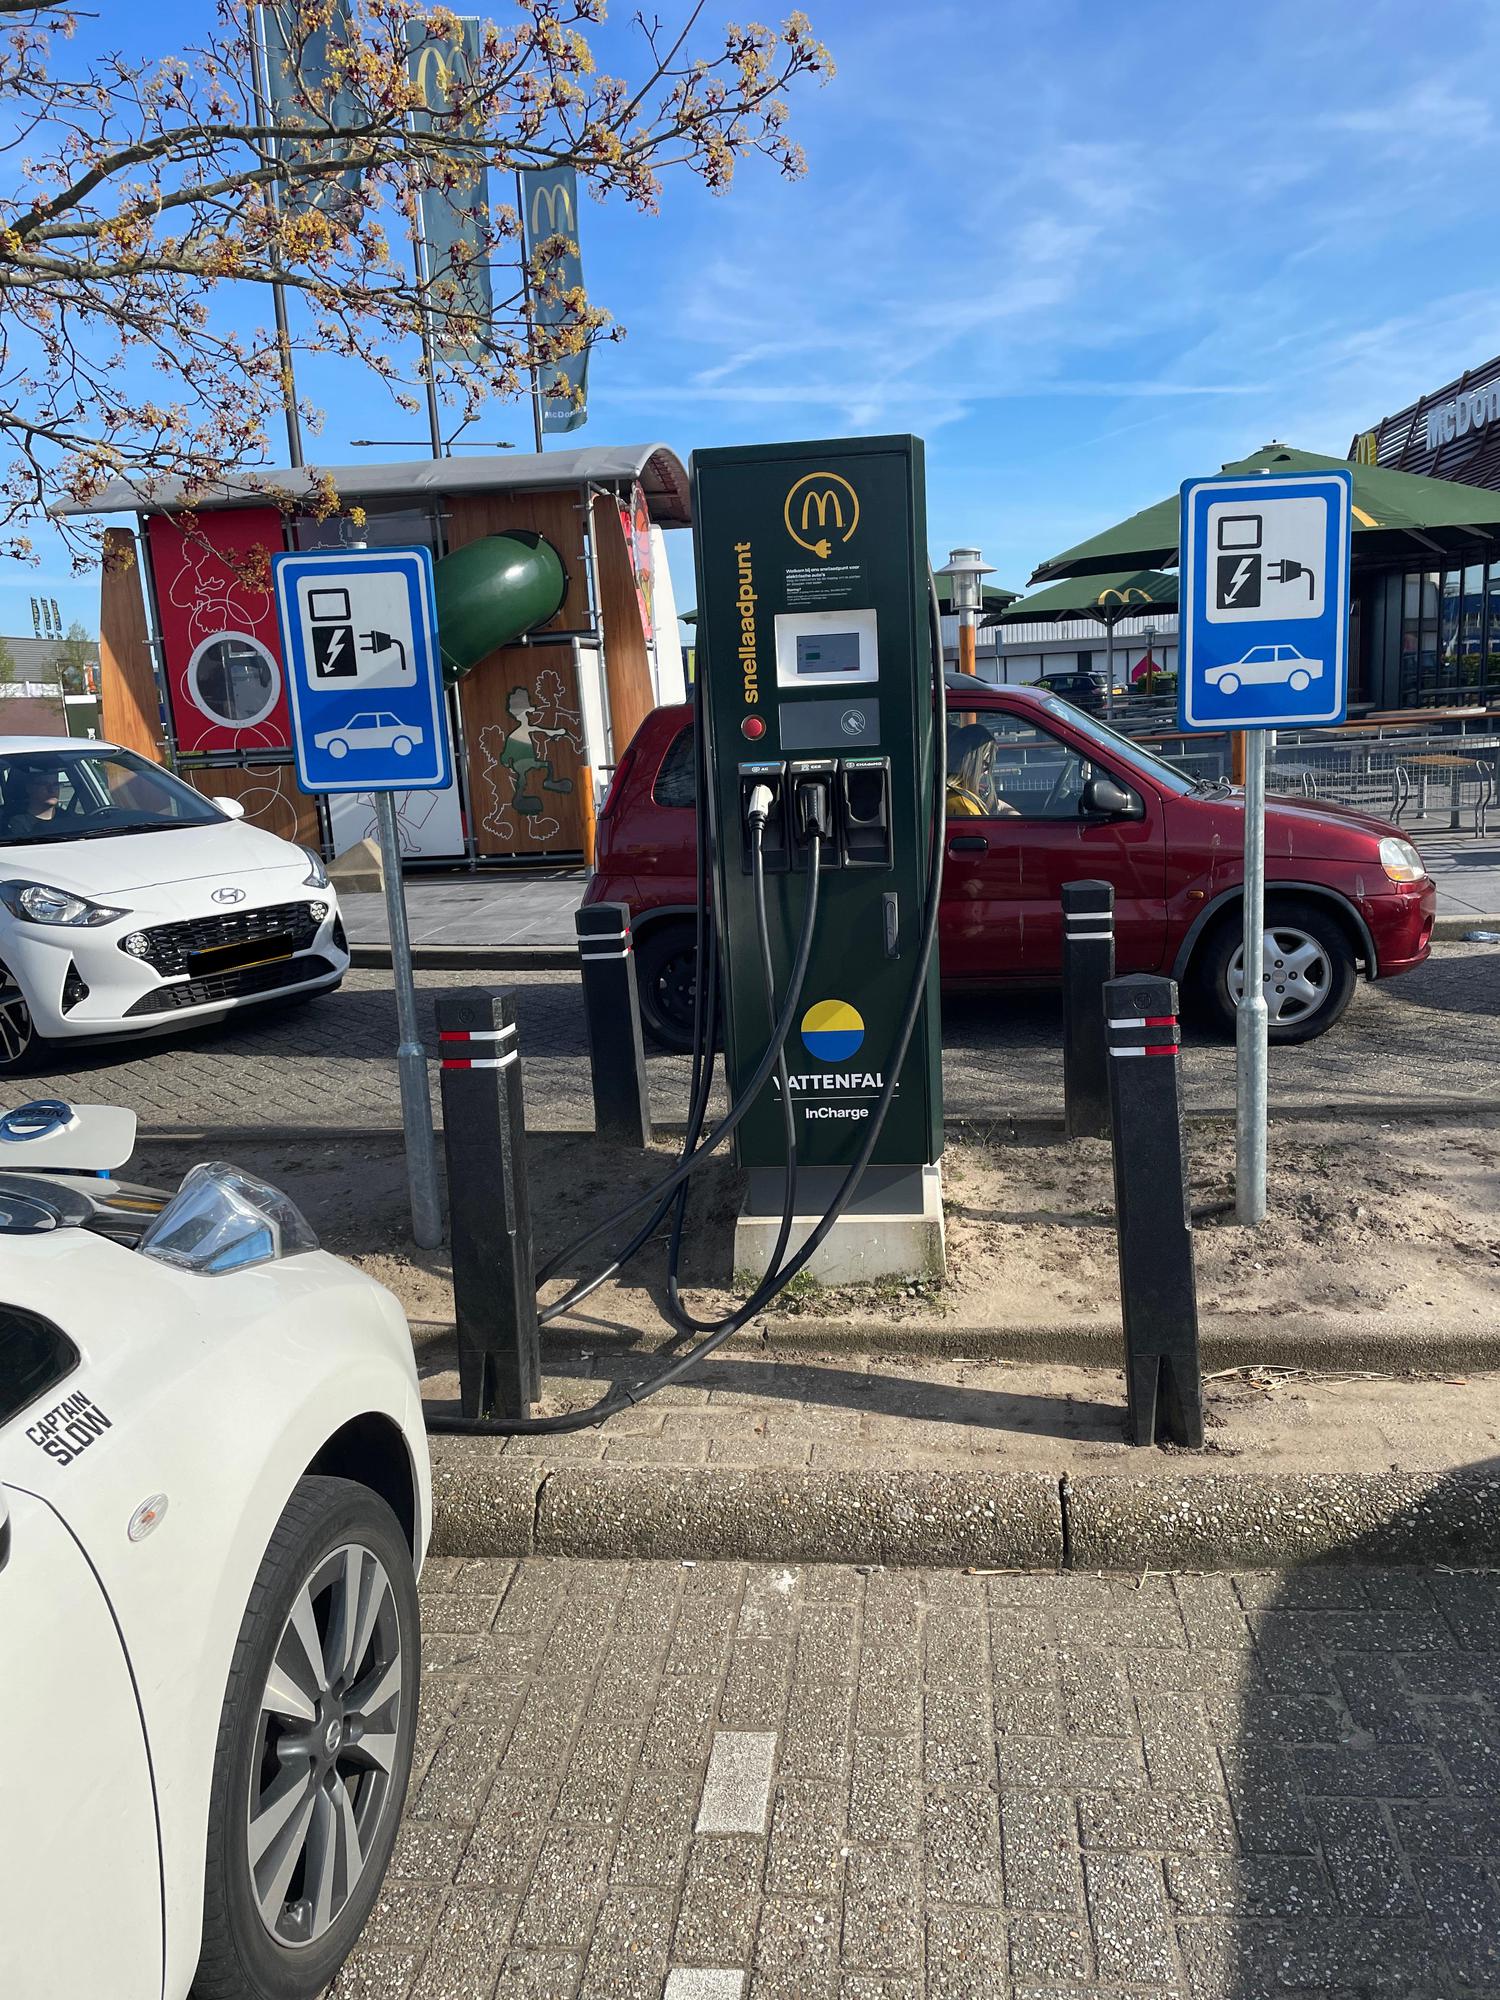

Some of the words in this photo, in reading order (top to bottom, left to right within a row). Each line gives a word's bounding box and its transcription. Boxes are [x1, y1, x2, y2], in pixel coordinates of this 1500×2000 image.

[734, 542, 758, 704] snellaadpunt
[773, 1073, 899, 1090] VATTENFAL
[805, 1107, 869, 1120] InCharge
[25, 1390, 92, 1446] CAPTAIN
[43, 1405, 113, 1466] SLOW
